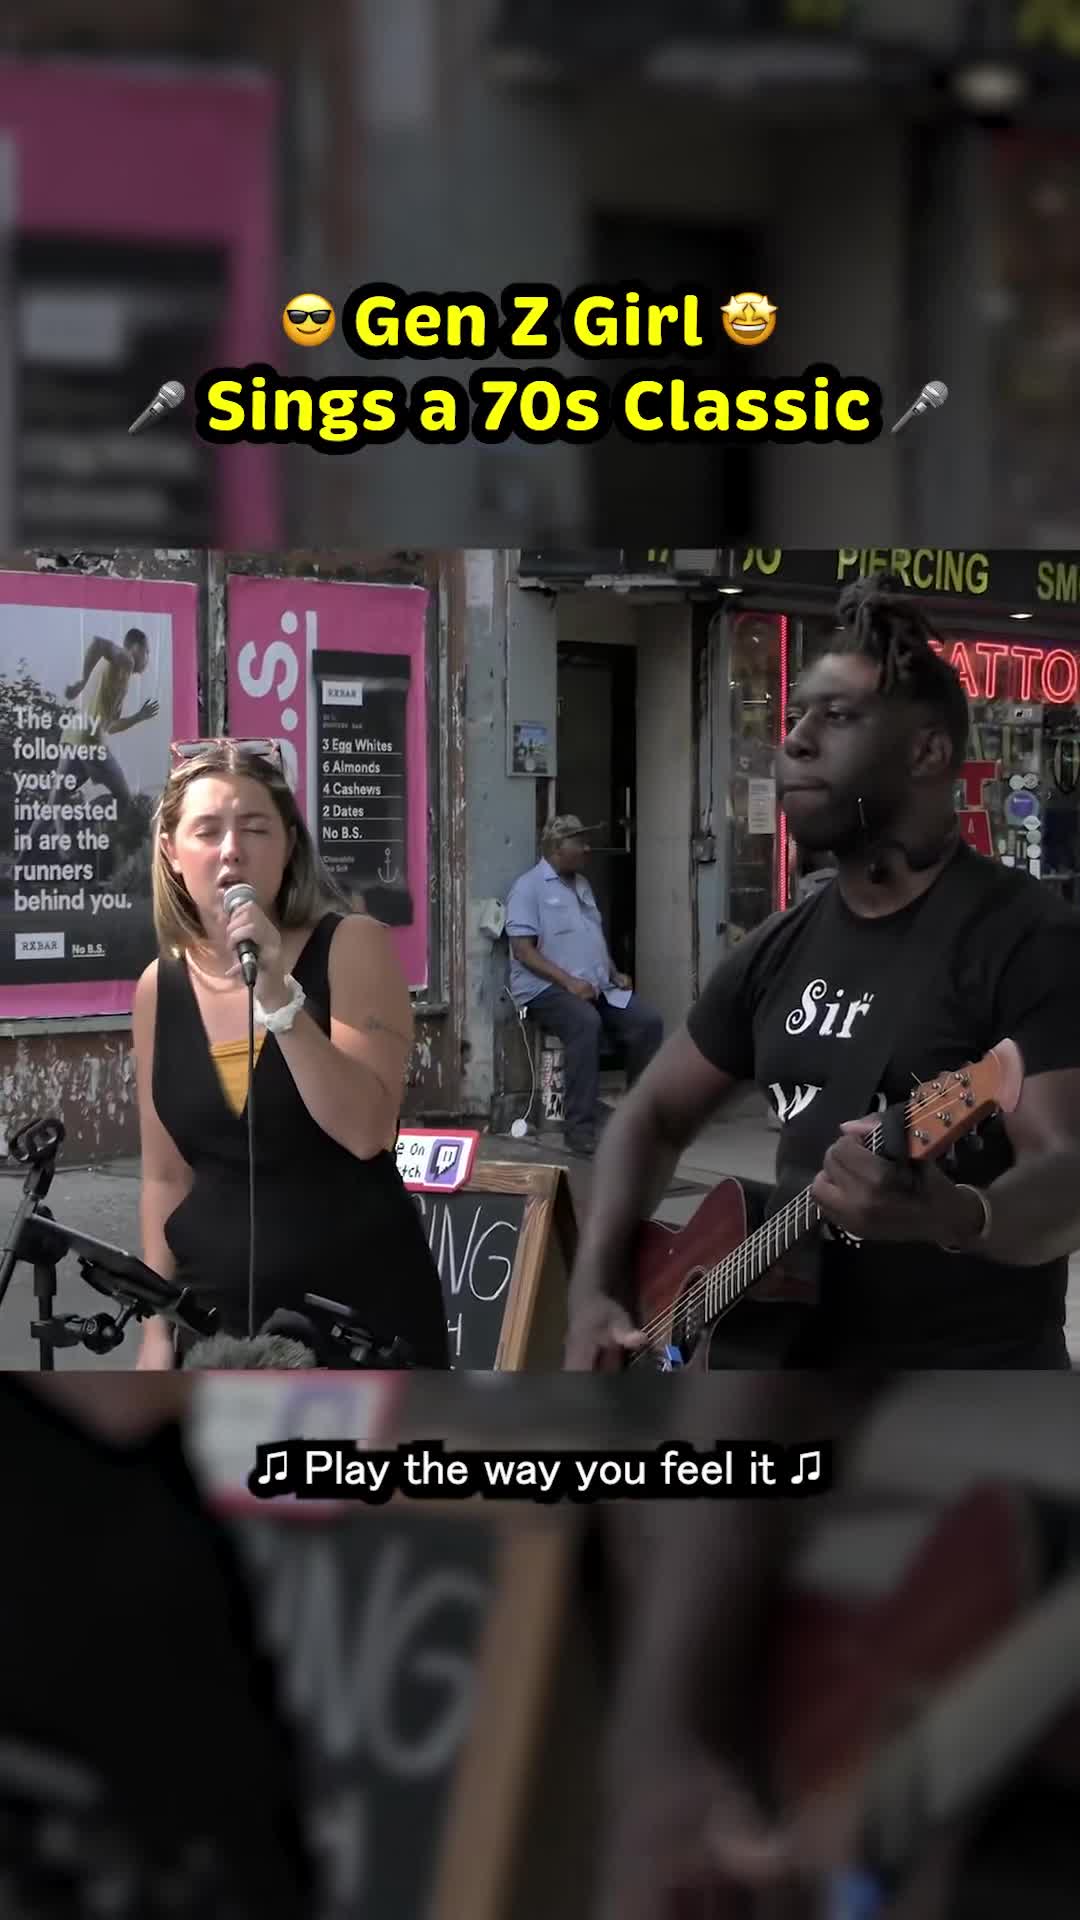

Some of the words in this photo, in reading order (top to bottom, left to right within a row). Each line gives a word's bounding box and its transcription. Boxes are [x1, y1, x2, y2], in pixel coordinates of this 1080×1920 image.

[837, 548, 989, 594] PIERCING
[1037, 560, 1080, 603] SM
[13, 705, 52, 729] The
[59, 709, 101, 736] only
[13, 737, 107, 760] followers
[322, 738, 330, 751] 3
[332, 738, 353, 754] Egg
[354, 739, 393, 752] Whites
[322, 760, 330, 773] 6
[332, 760, 380, 773] Almonds
[322, 782, 330, 795] 4
[333, 782, 381, 795] Cashews
[14, 799, 118, 821] interested
[322, 805, 330, 817] 2
[333, 805, 364, 817] Dates
[14, 828, 33, 851] in
[39, 833, 72, 851] are
[76, 828, 110, 850] the
[322, 826, 338, 839] No
[341, 826, 363, 839] B.S.
[14, 863, 94, 881] runners
[14, 888, 85, 911] behind
[89, 893, 133, 915] you.
[72, 944, 85, 954] No
[87, 943, 105, 954] B.S.
